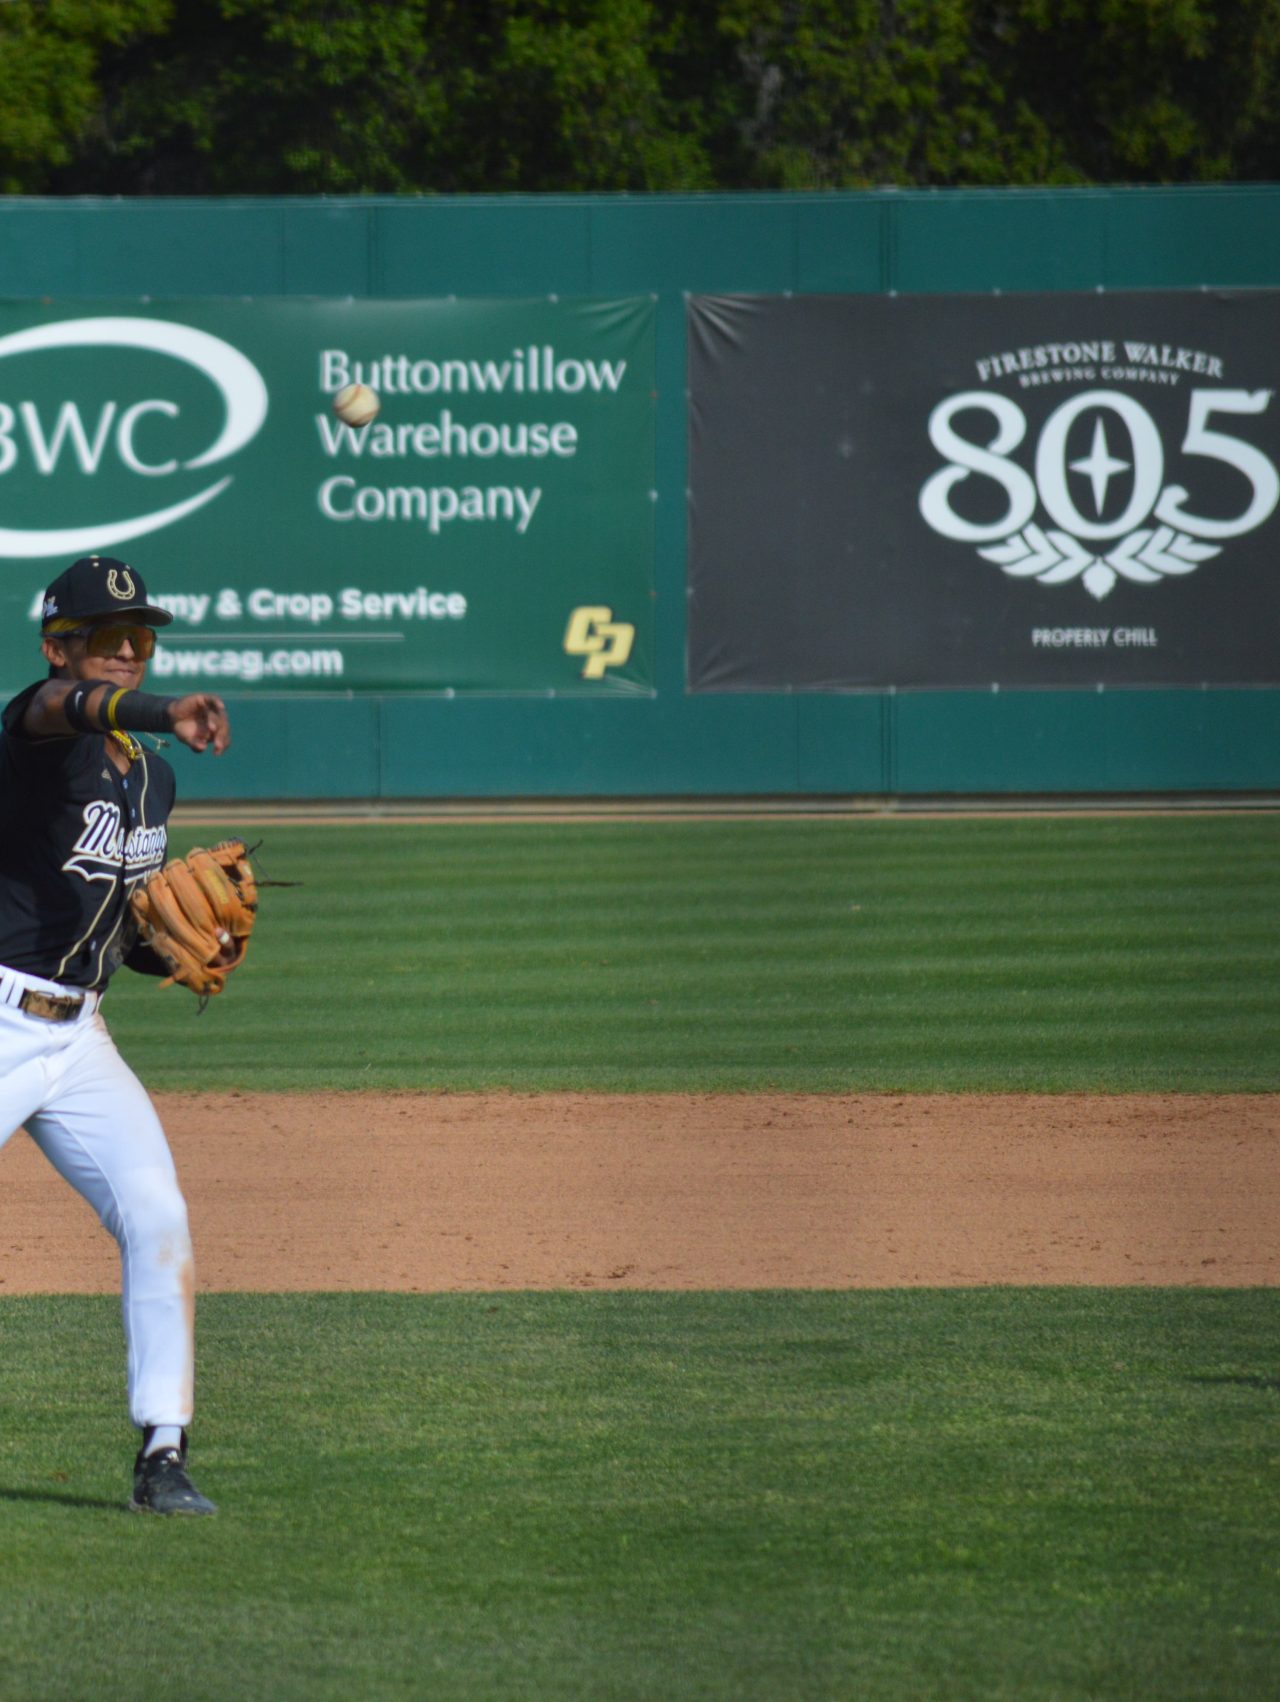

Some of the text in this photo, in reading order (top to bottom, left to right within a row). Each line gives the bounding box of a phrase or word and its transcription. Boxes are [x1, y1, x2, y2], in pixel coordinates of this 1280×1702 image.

[321, 344, 627, 395] Buttonwillow
[976, 340, 1224, 383] FIRESTONE WALKER
[1019, 366, 1180, 388] BREWING COMPANY
[316, 409, 578, 458] Warehouse
[919, 388, 1280, 542] 805
[318, 474, 542, 535] Company
[215, 587, 242, 618] &
[248, 587, 333, 625] Crop
[340, 587, 468, 619] Service
[1031, 627, 1159, 648] PROPERLY CHILL
[152, 646, 344, 681] bwcag.com
